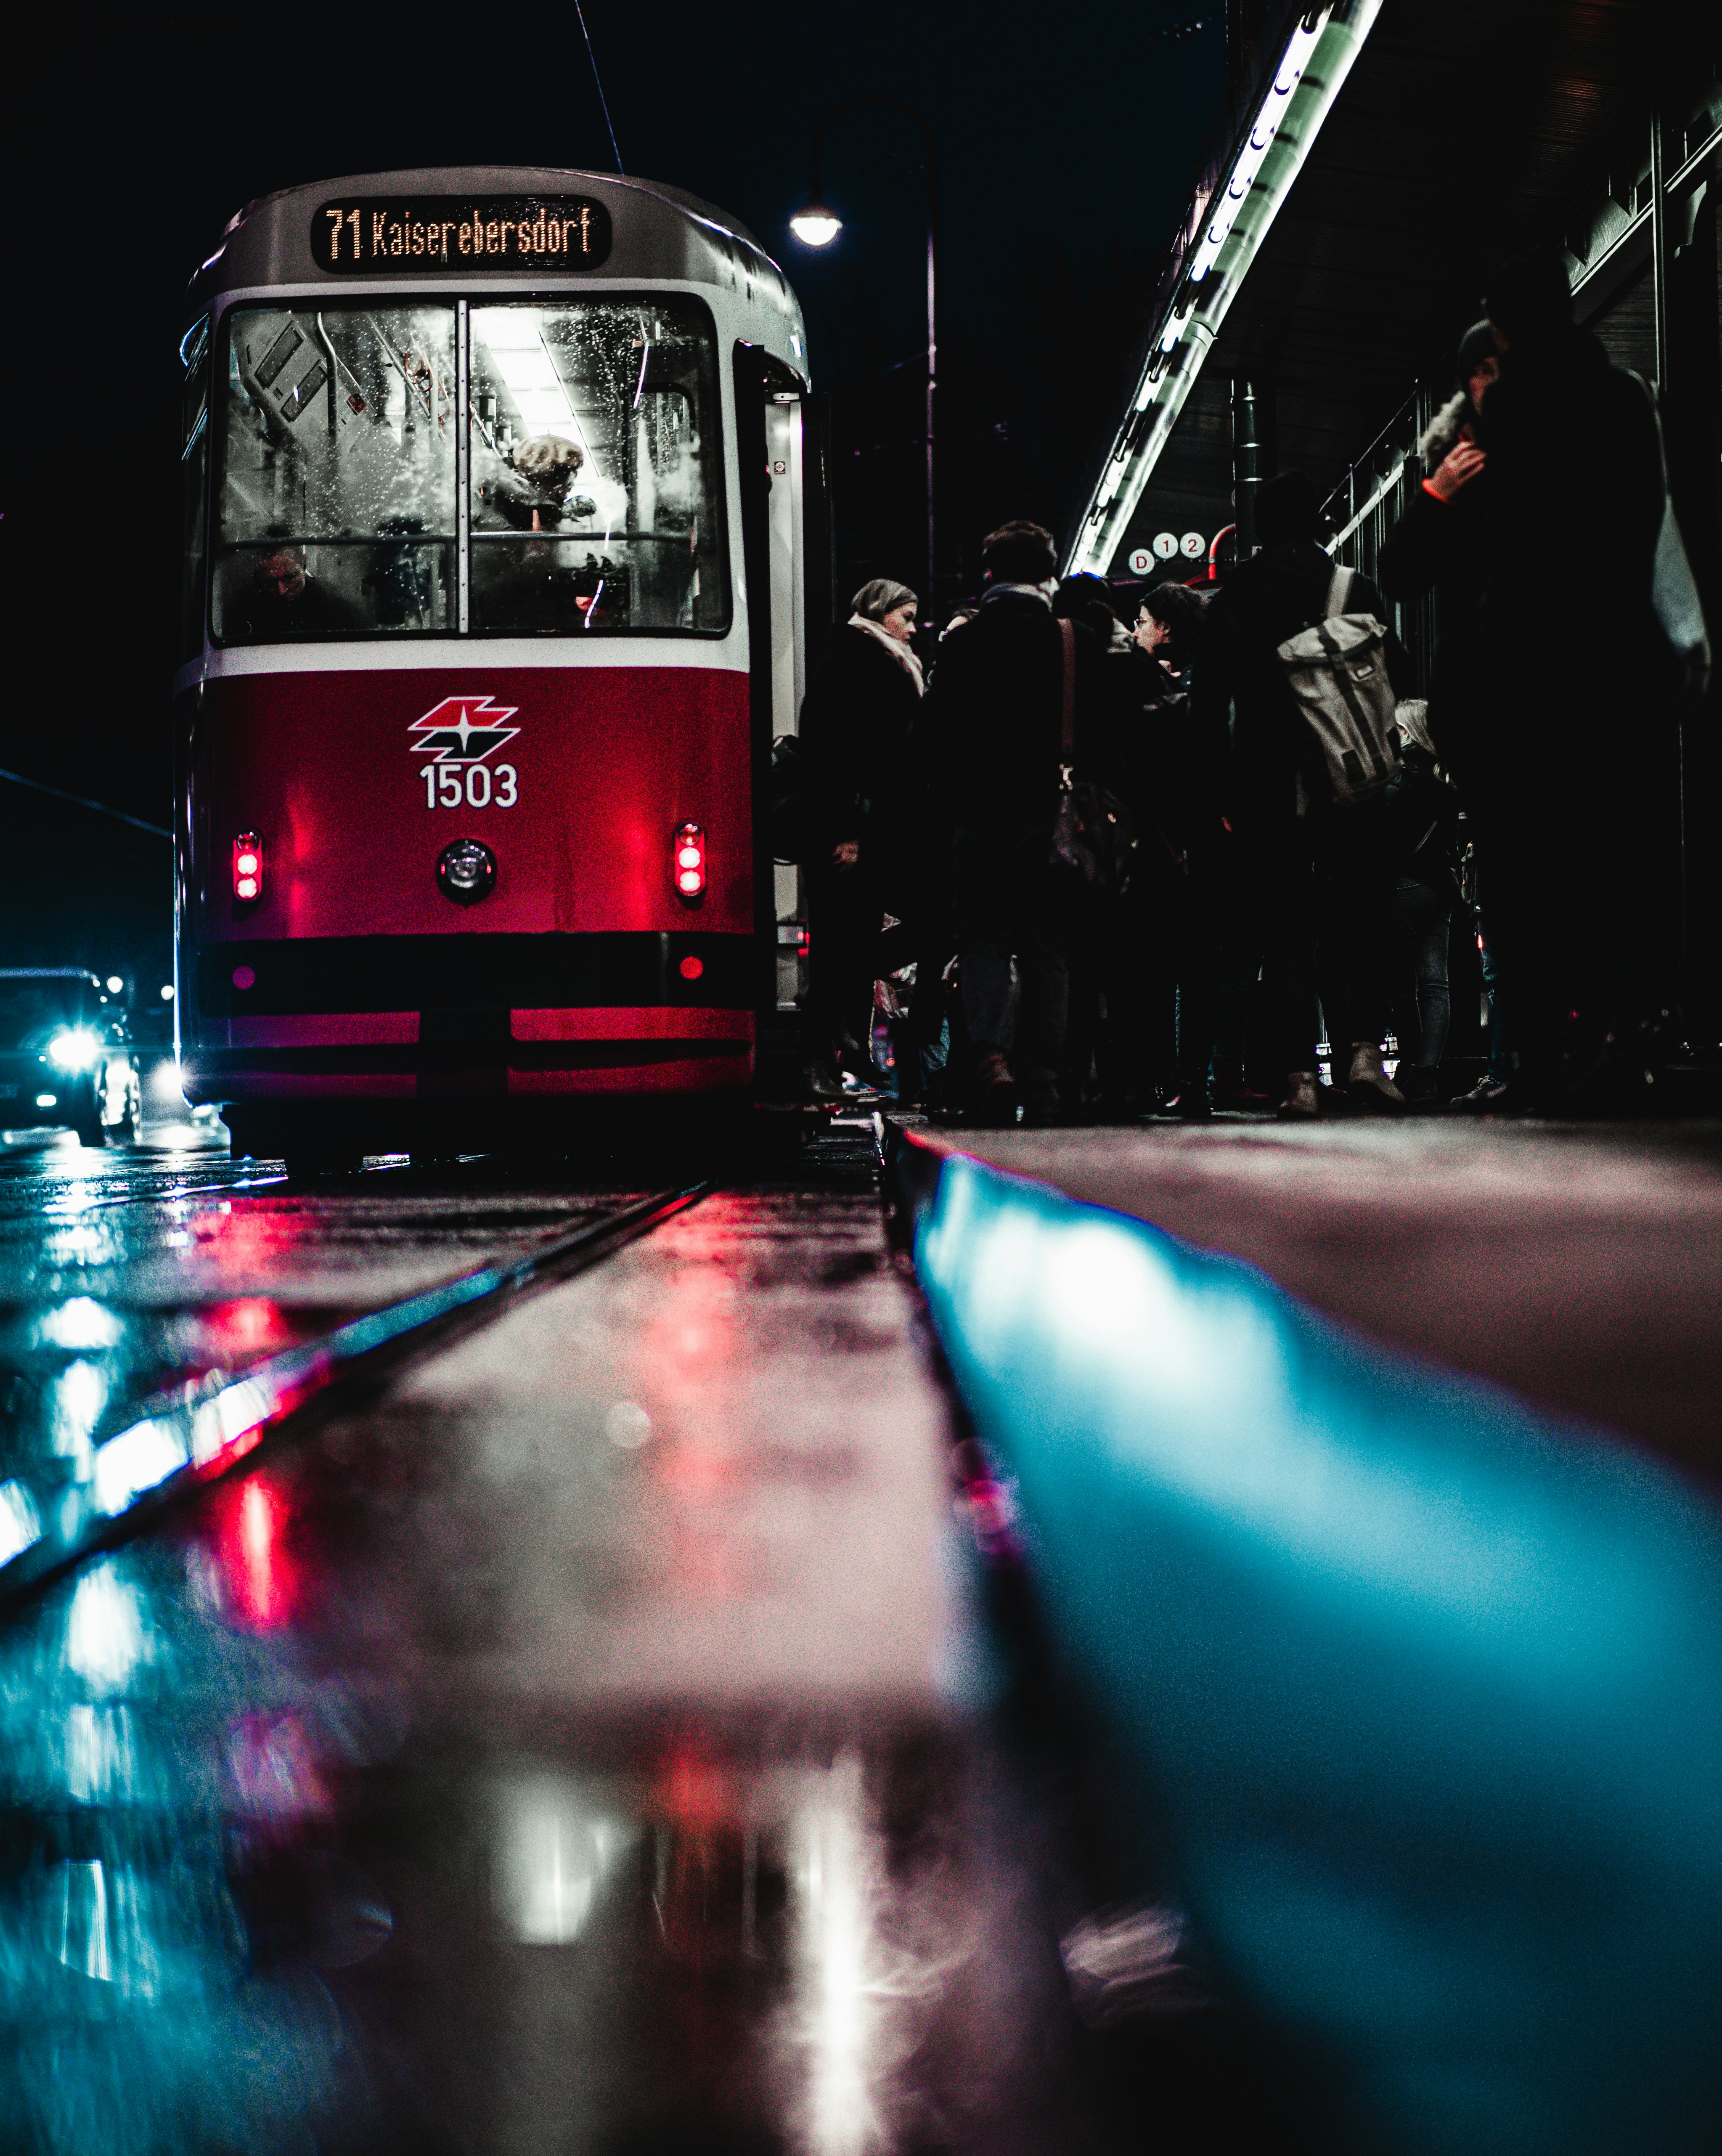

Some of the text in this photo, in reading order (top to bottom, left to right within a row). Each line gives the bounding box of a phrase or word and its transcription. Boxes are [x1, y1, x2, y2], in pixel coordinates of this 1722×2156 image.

[326, 208, 590, 259] 71 Kaiserebersdorf
[1136, 539, 1197, 569] D 1 2
[420, 764, 517, 809] 1503
